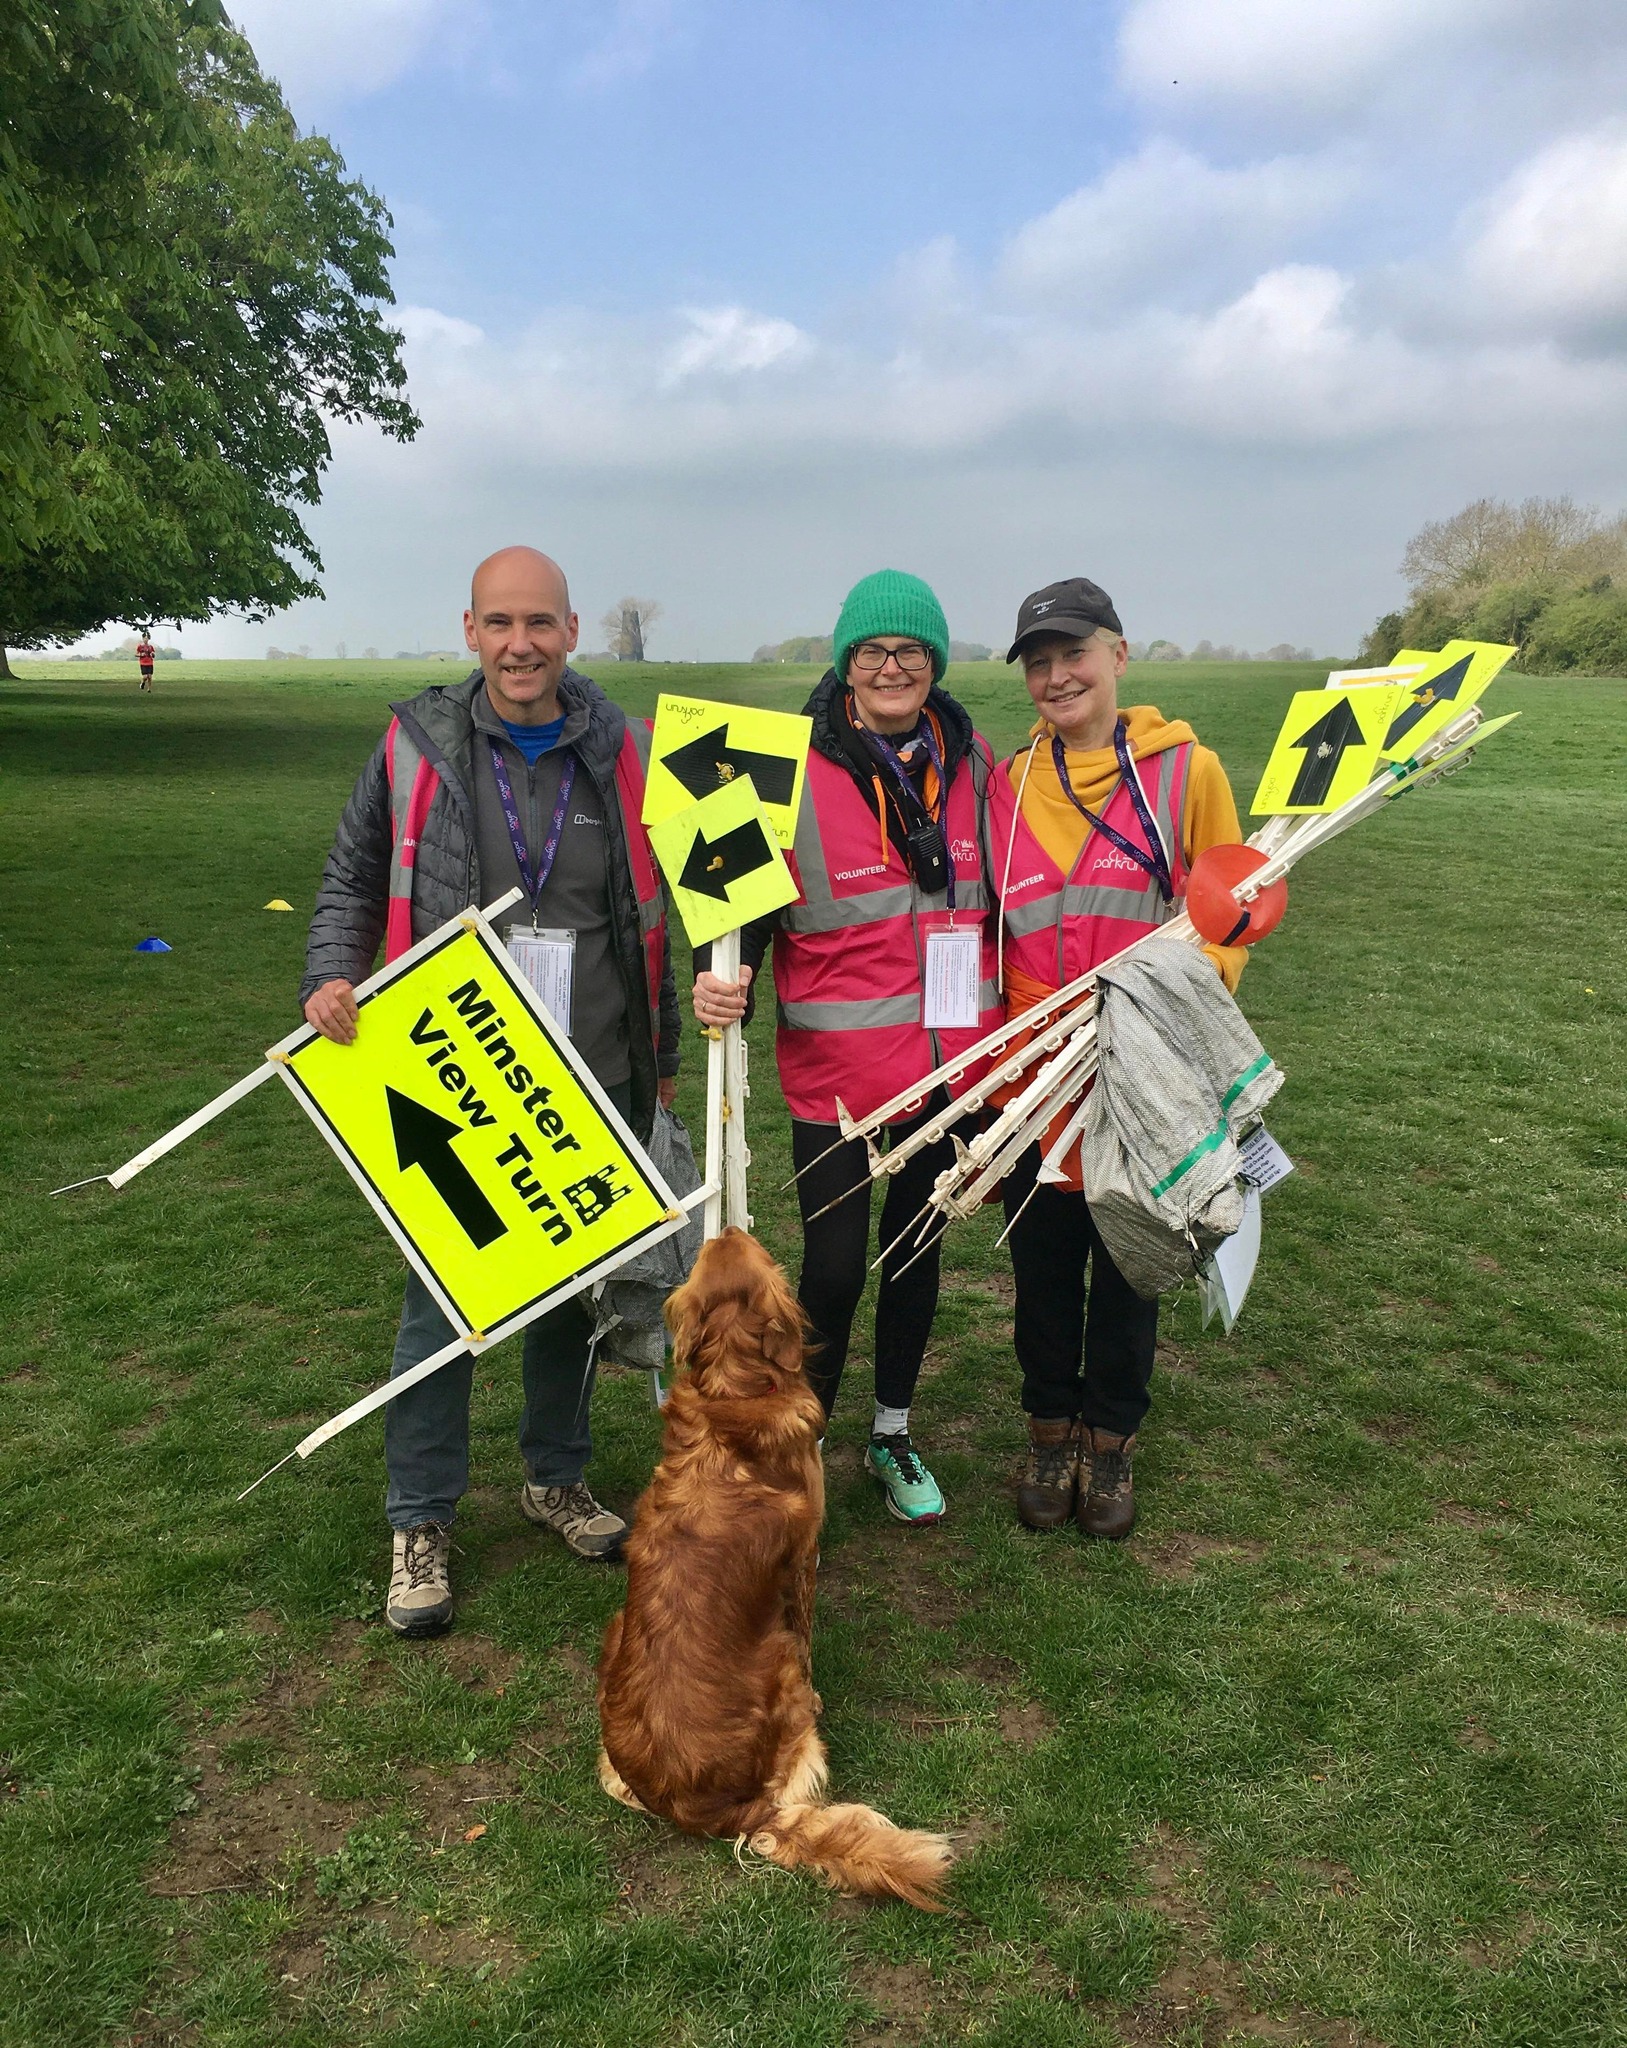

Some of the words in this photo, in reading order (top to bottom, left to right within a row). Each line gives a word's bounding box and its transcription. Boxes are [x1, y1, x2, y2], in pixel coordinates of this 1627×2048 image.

[666, 704, 706, 724] parkrun
[834, 864, 886, 880] VOLUNTEER
[448, 978, 582, 1154] Minster
[409, 1007, 498, 1128] View
[495, 1132, 573, 1247] Turn
[1252, 1154, 1265, 1165] Orange
